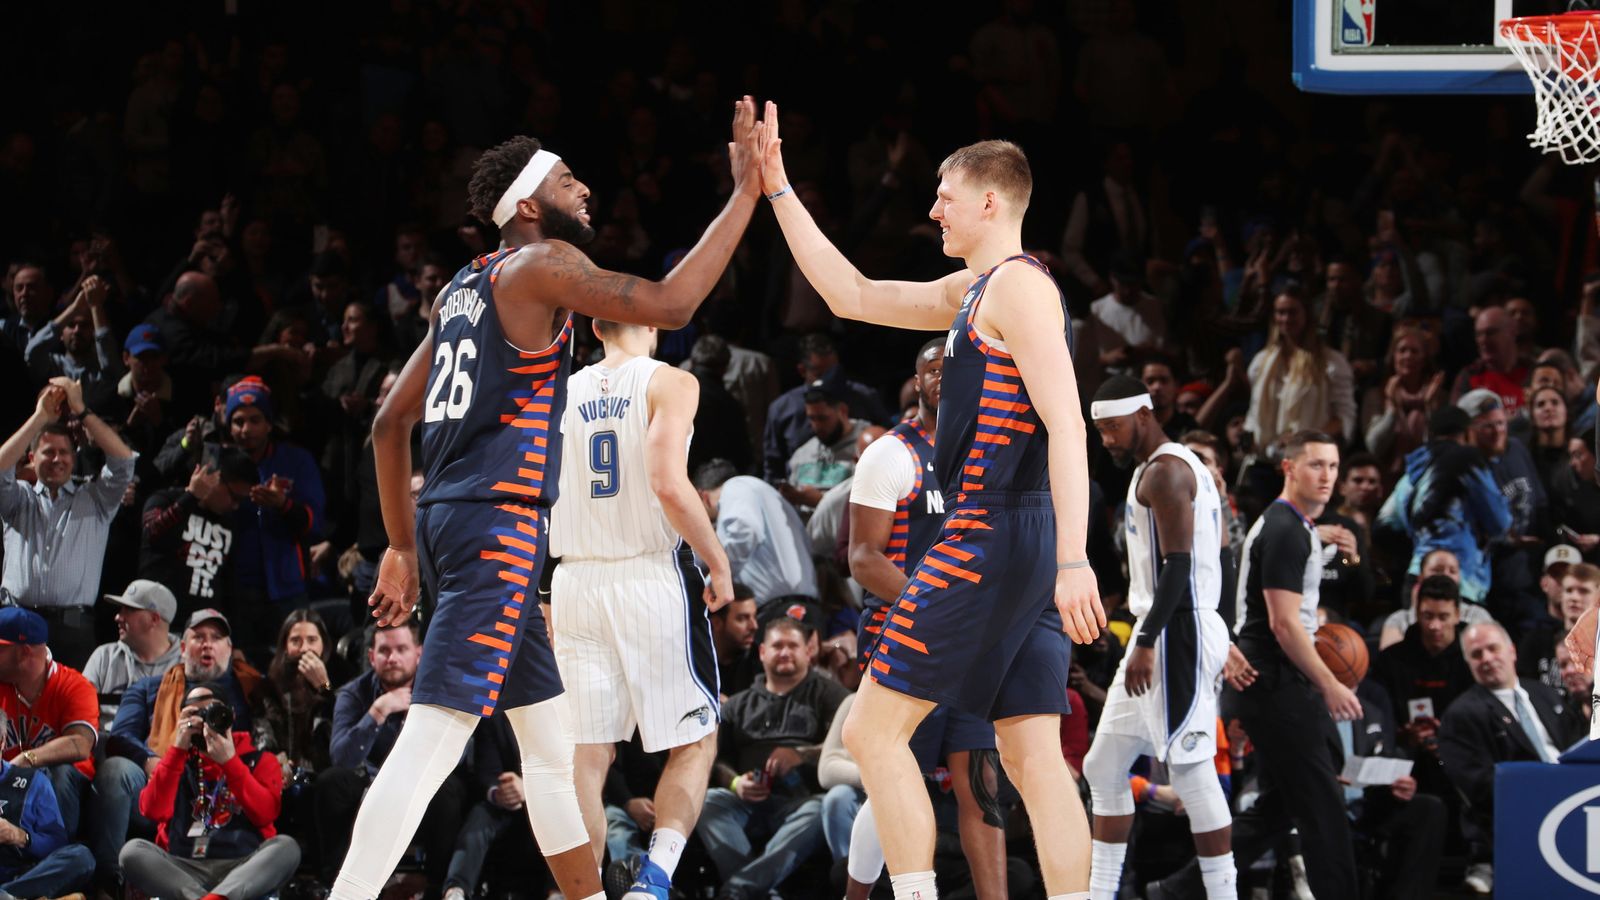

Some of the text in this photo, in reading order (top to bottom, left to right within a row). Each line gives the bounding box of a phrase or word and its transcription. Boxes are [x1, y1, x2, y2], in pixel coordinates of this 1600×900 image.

[424, 338, 478, 423] 26
[577, 395, 632, 423] VUČVIĆ
[589, 430, 621, 498] 9
[182, 513, 233, 555] JUST
[12, 776, 28, 789] 20
